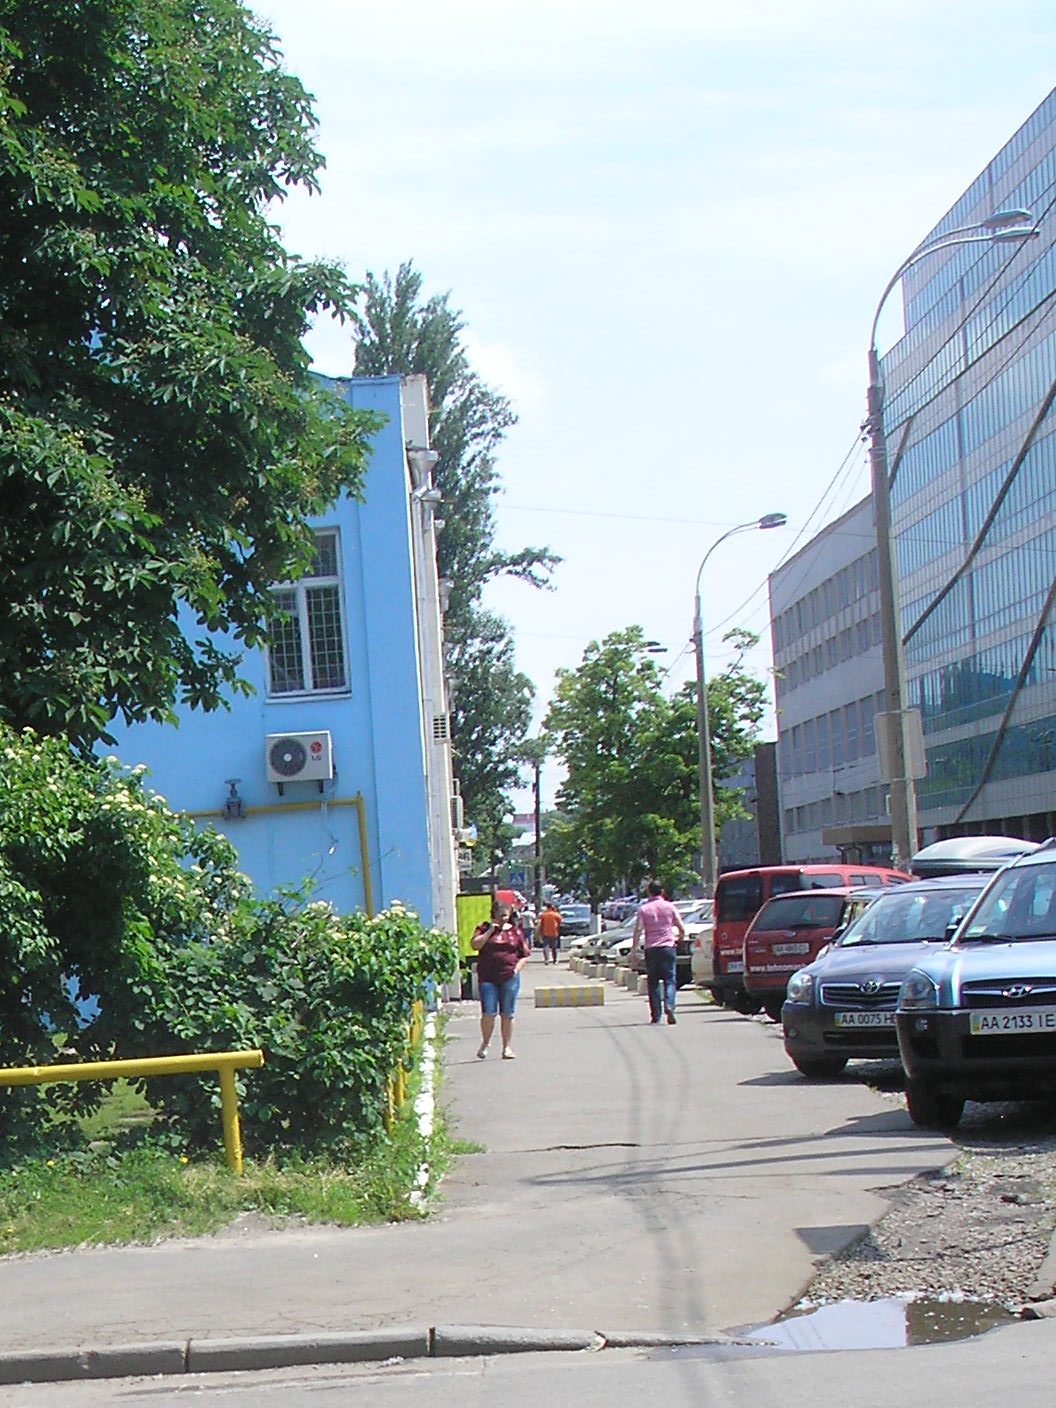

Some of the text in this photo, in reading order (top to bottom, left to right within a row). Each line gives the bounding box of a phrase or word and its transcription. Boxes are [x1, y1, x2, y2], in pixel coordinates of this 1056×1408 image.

[842, 1014, 855, 1025] AA
[857, 1014, 881, 1025] 0075
[981, 1013, 1055, 1030] AA 2133 IE
